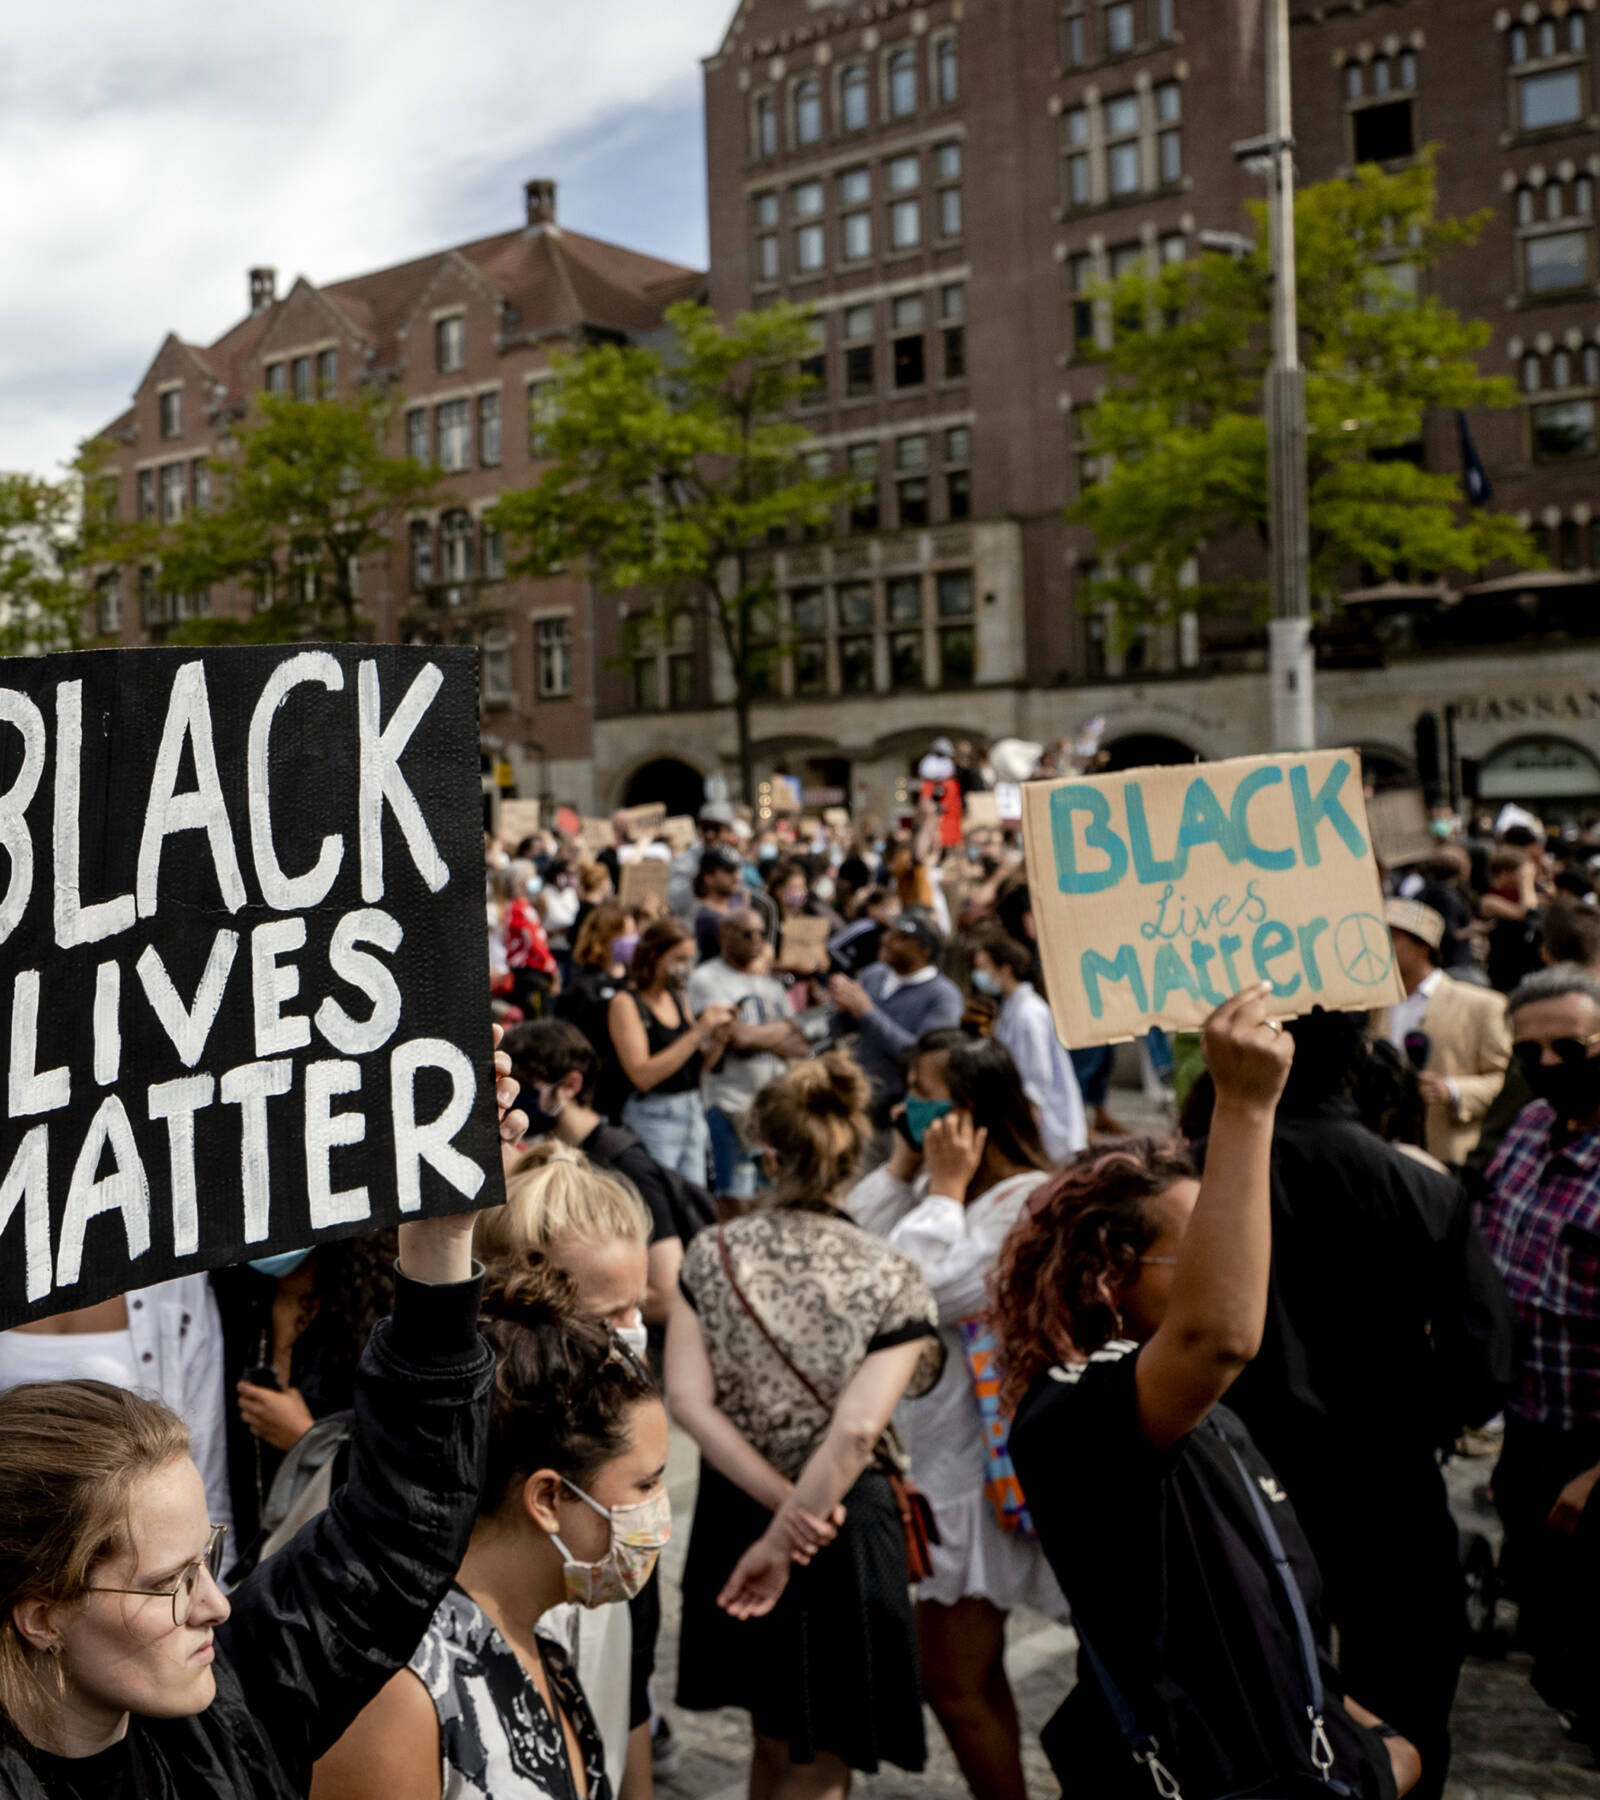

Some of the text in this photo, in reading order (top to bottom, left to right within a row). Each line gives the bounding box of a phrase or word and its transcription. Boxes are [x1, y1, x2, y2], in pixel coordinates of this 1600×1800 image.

[1050, 759, 1368, 895] BLACK
[1141, 879, 1268, 940] Lives
[9, 908, 403, 1118] LIVES
